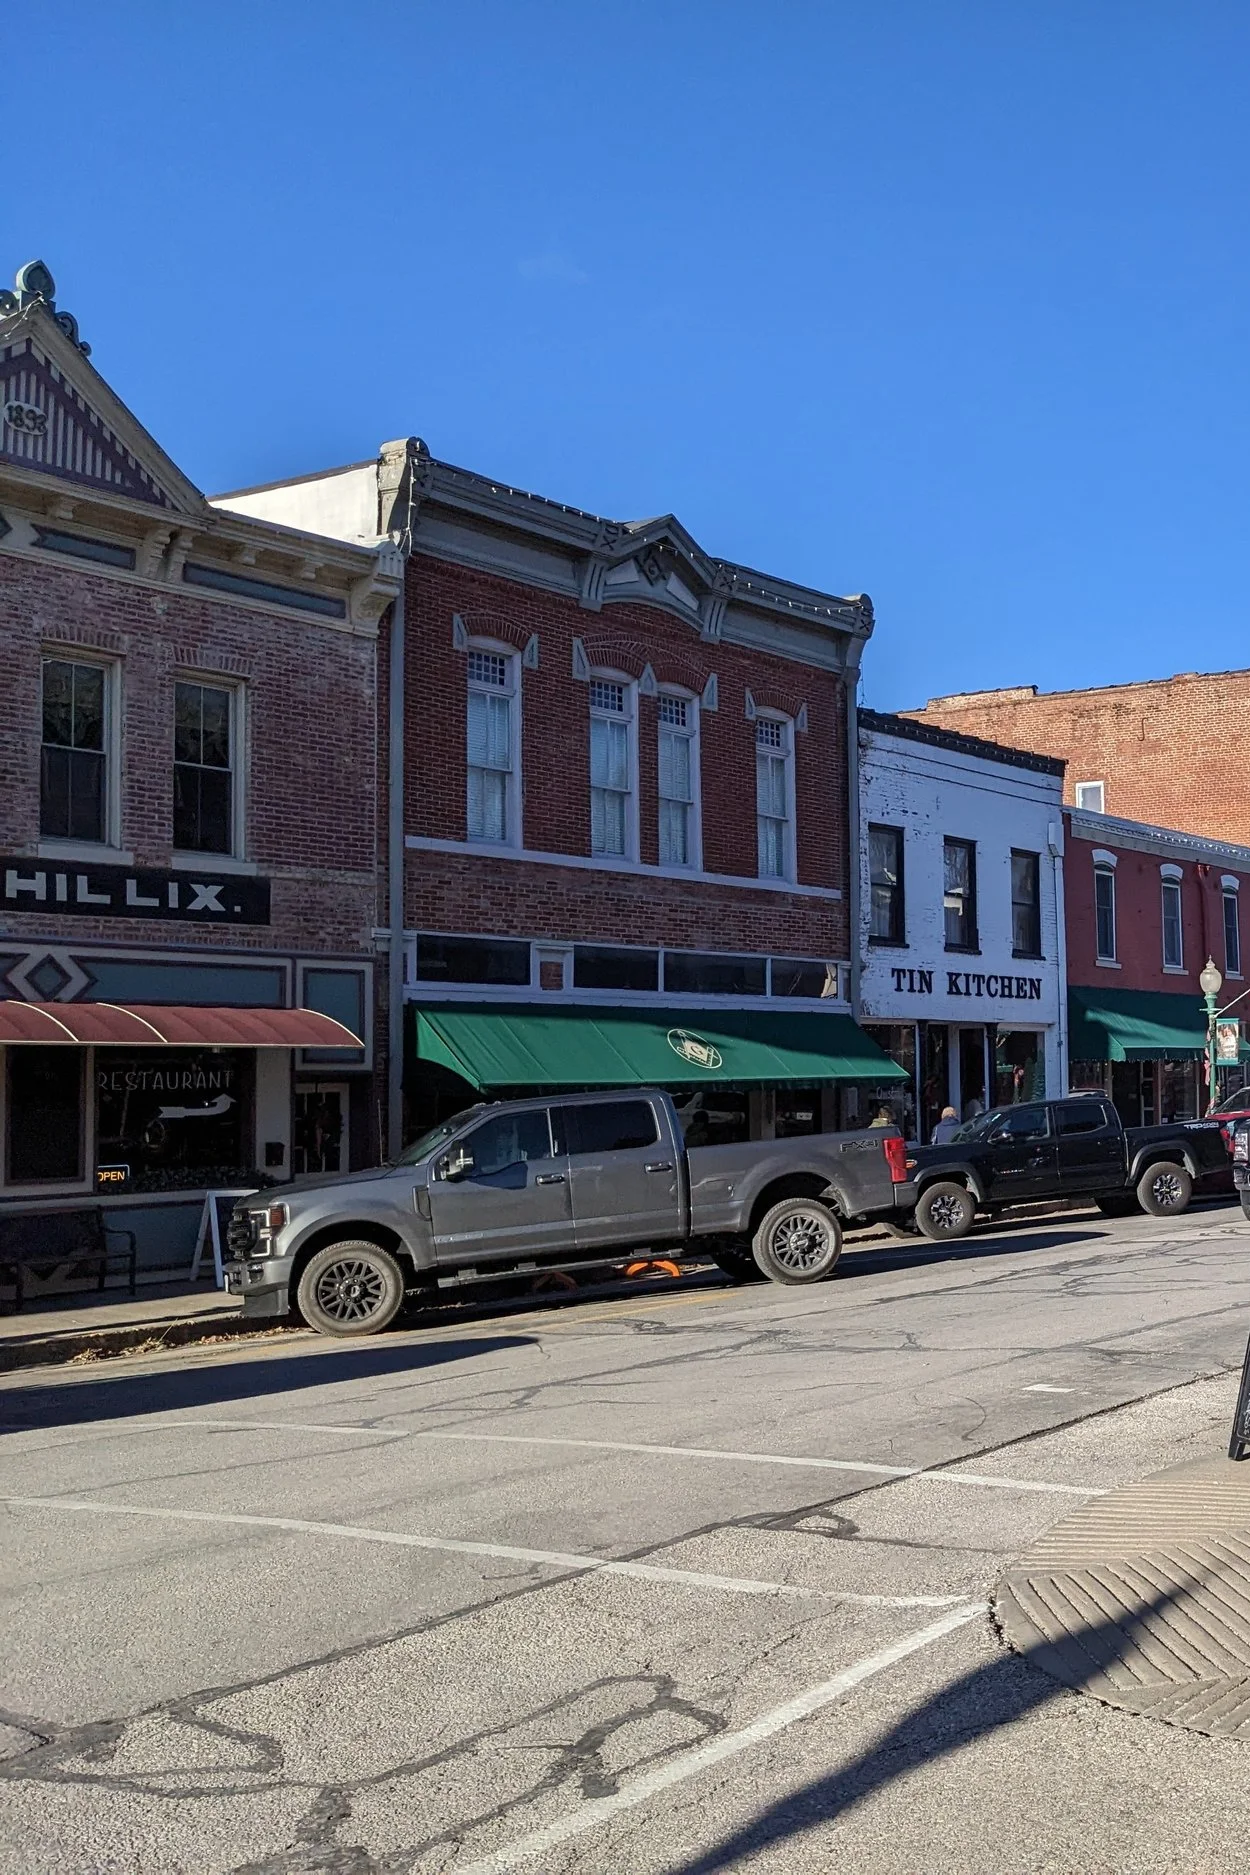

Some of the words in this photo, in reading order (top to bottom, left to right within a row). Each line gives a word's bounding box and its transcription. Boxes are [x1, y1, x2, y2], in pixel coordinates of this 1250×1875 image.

[891, 967, 934, 994] TIN
[946, 971, 1042, 1000] KITCHEN
[98, 1070, 231, 1091] RESTAURANT
[97, 1171, 126, 1182] OPEN
